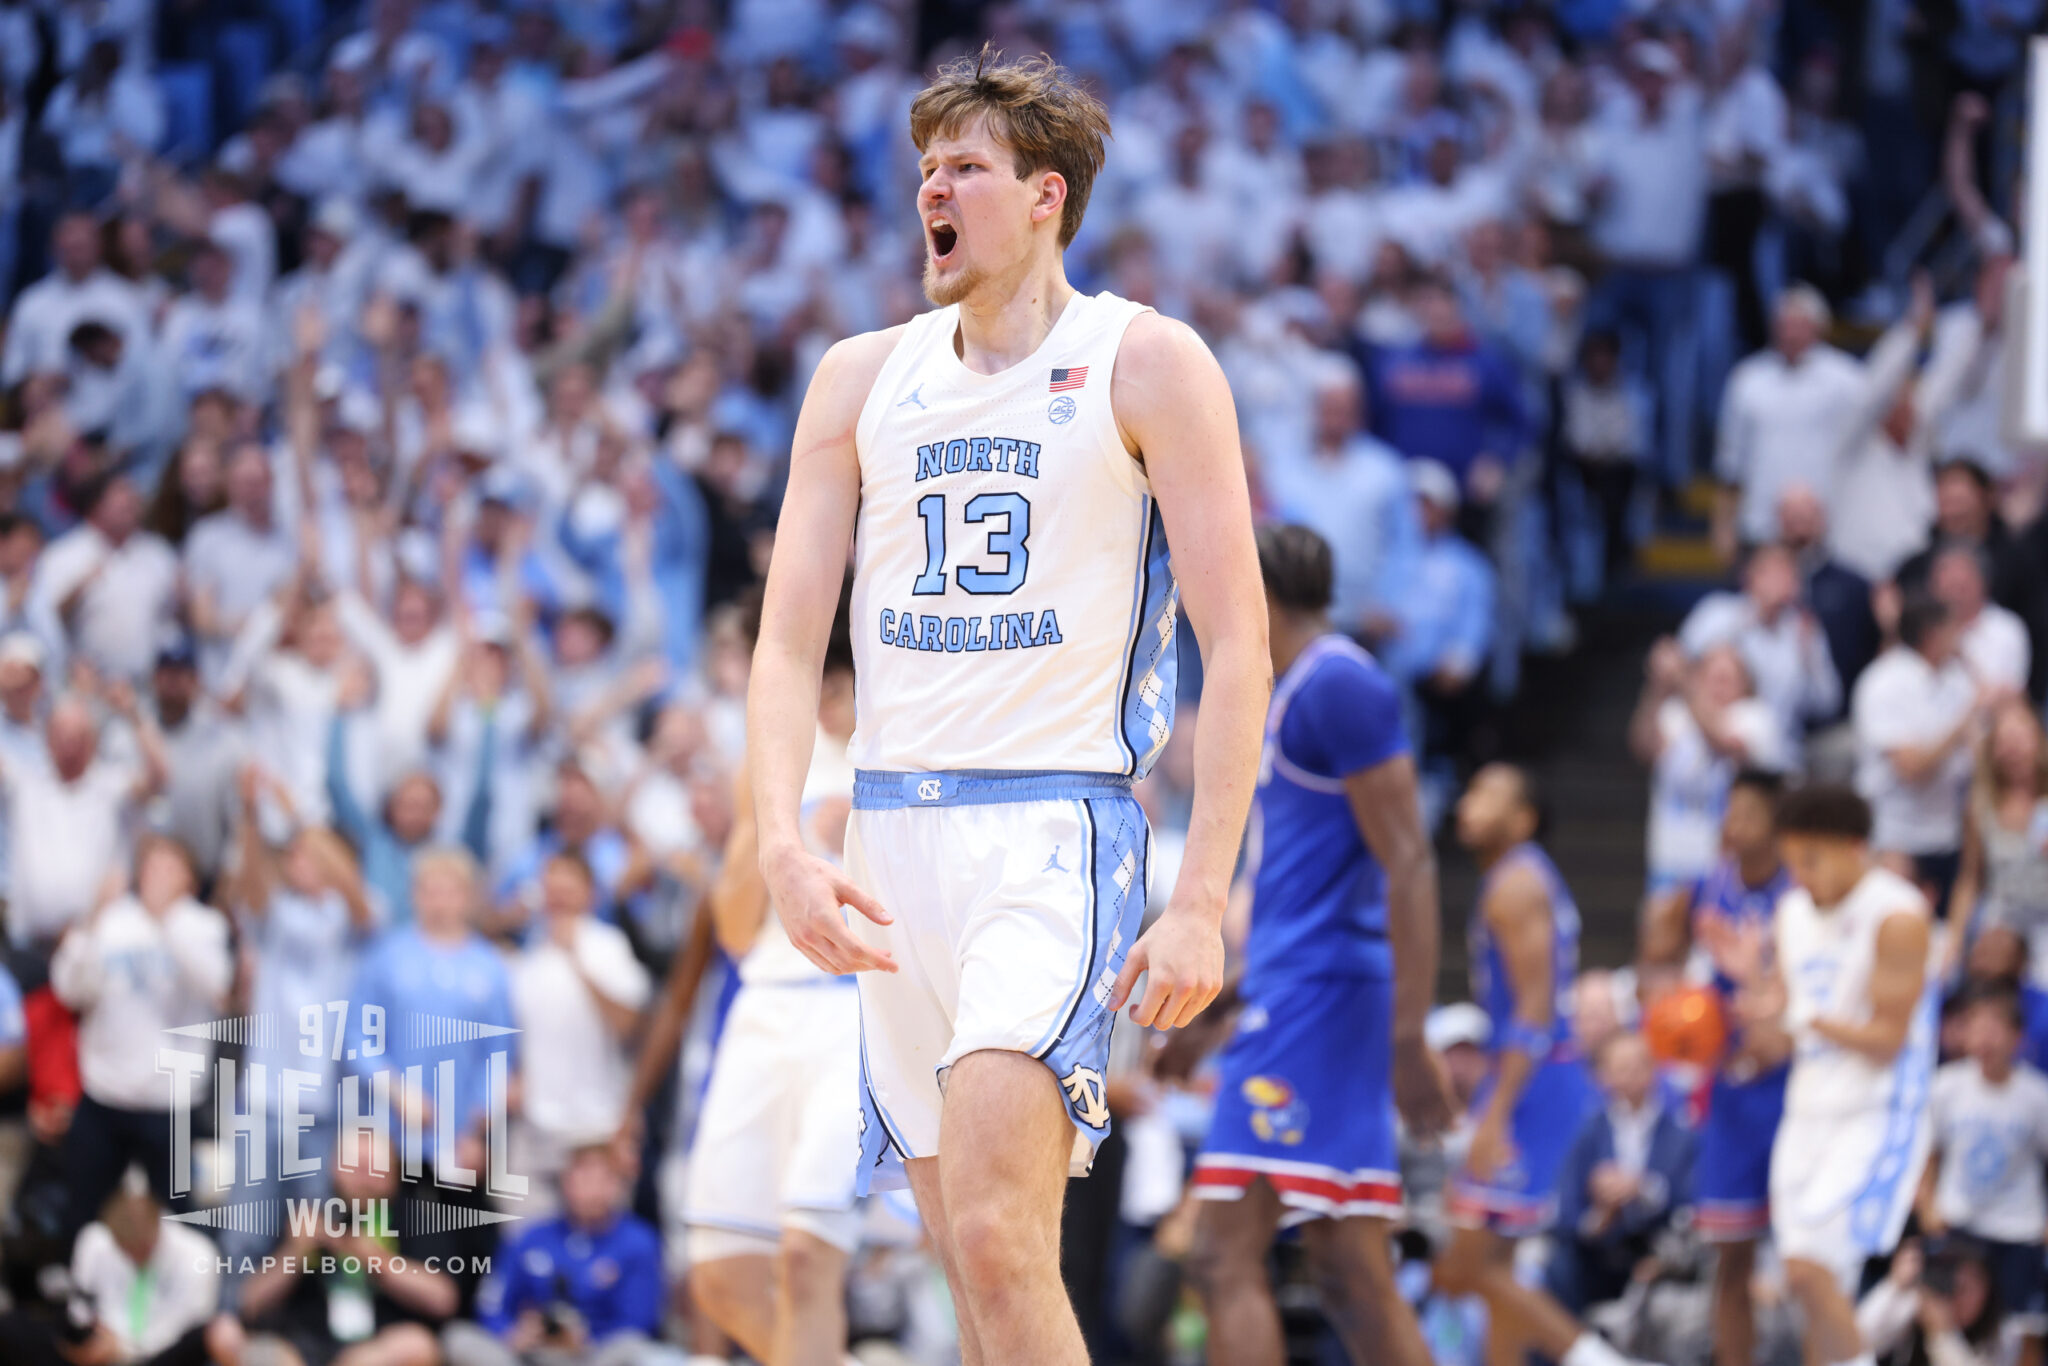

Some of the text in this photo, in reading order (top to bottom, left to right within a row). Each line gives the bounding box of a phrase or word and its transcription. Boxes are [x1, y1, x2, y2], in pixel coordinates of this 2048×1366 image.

[915, 436, 1041, 483] NORTH
[912, 491, 1031, 596] 13
[880, 607, 1063, 653] CAROLINA
